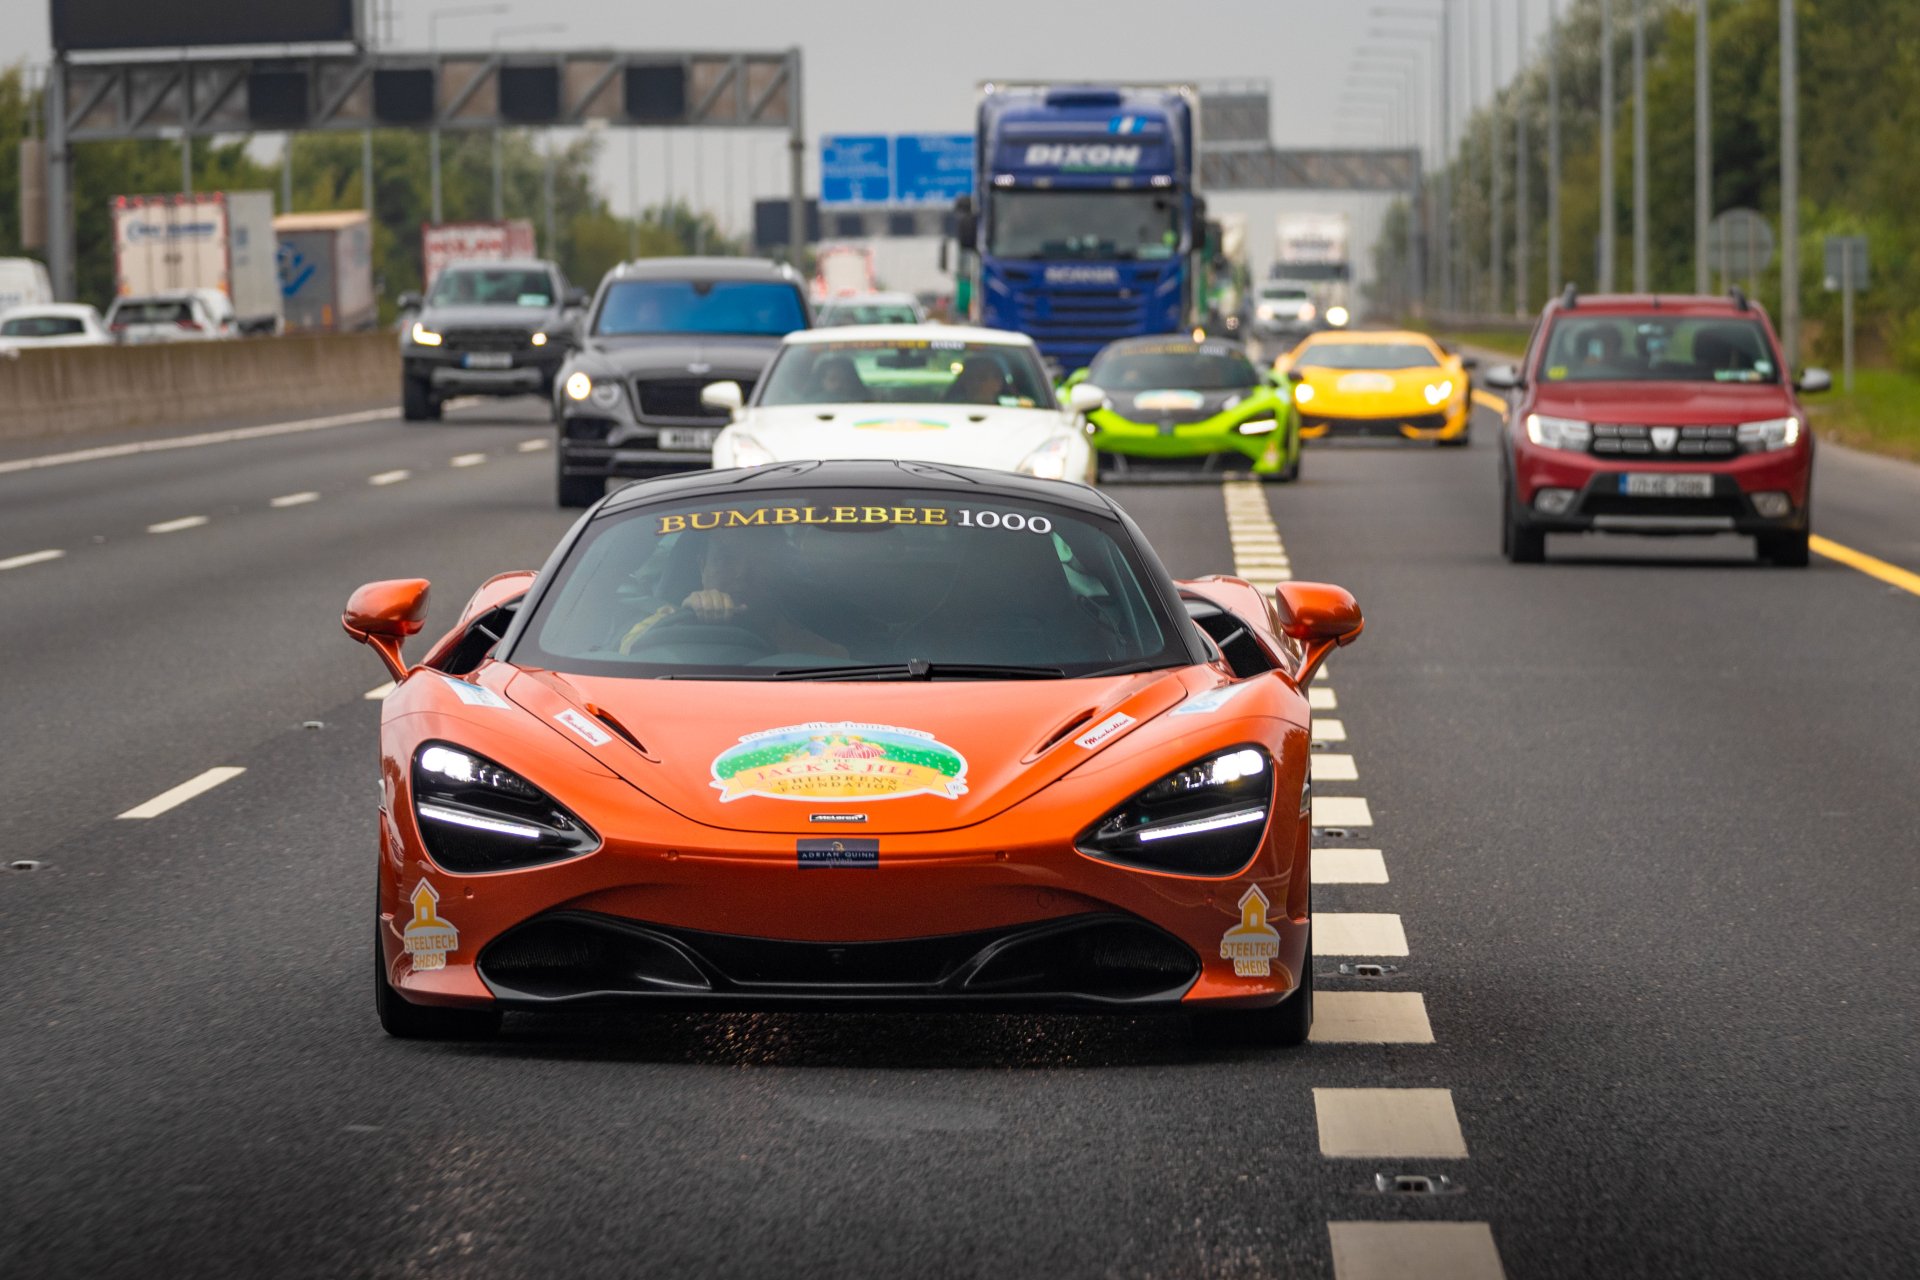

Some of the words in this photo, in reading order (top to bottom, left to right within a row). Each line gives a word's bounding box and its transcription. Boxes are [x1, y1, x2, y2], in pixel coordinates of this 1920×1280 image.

[1025, 144, 1141, 167] DIXON
[1044, 267, 1118, 283] SCANIA
[657, 505, 948, 535] BUMBLEBEE
[957, 509, 1053, 535] 1000
[808, 722, 839, 730] like
[844, 722, 888, 731] home
[895, 726, 929, 738] care
[756, 762, 821, 781] JACK
[833, 762, 853, 772] &
[865, 763, 920, 777] JILL
[777, 774, 899, 786] CHILDREN'S
[780, 781, 899, 793] FOUNDATION
[802, 851, 839, 859] ADRIAN
[844, 851, 875, 859] QUINN
[405, 933, 456, 952] STEELTECH
[1221, 941, 1278, 958] STEELTECH
[414, 952, 445, 968] SHEDS
[1235, 959, 1270, 975] SHEDS
